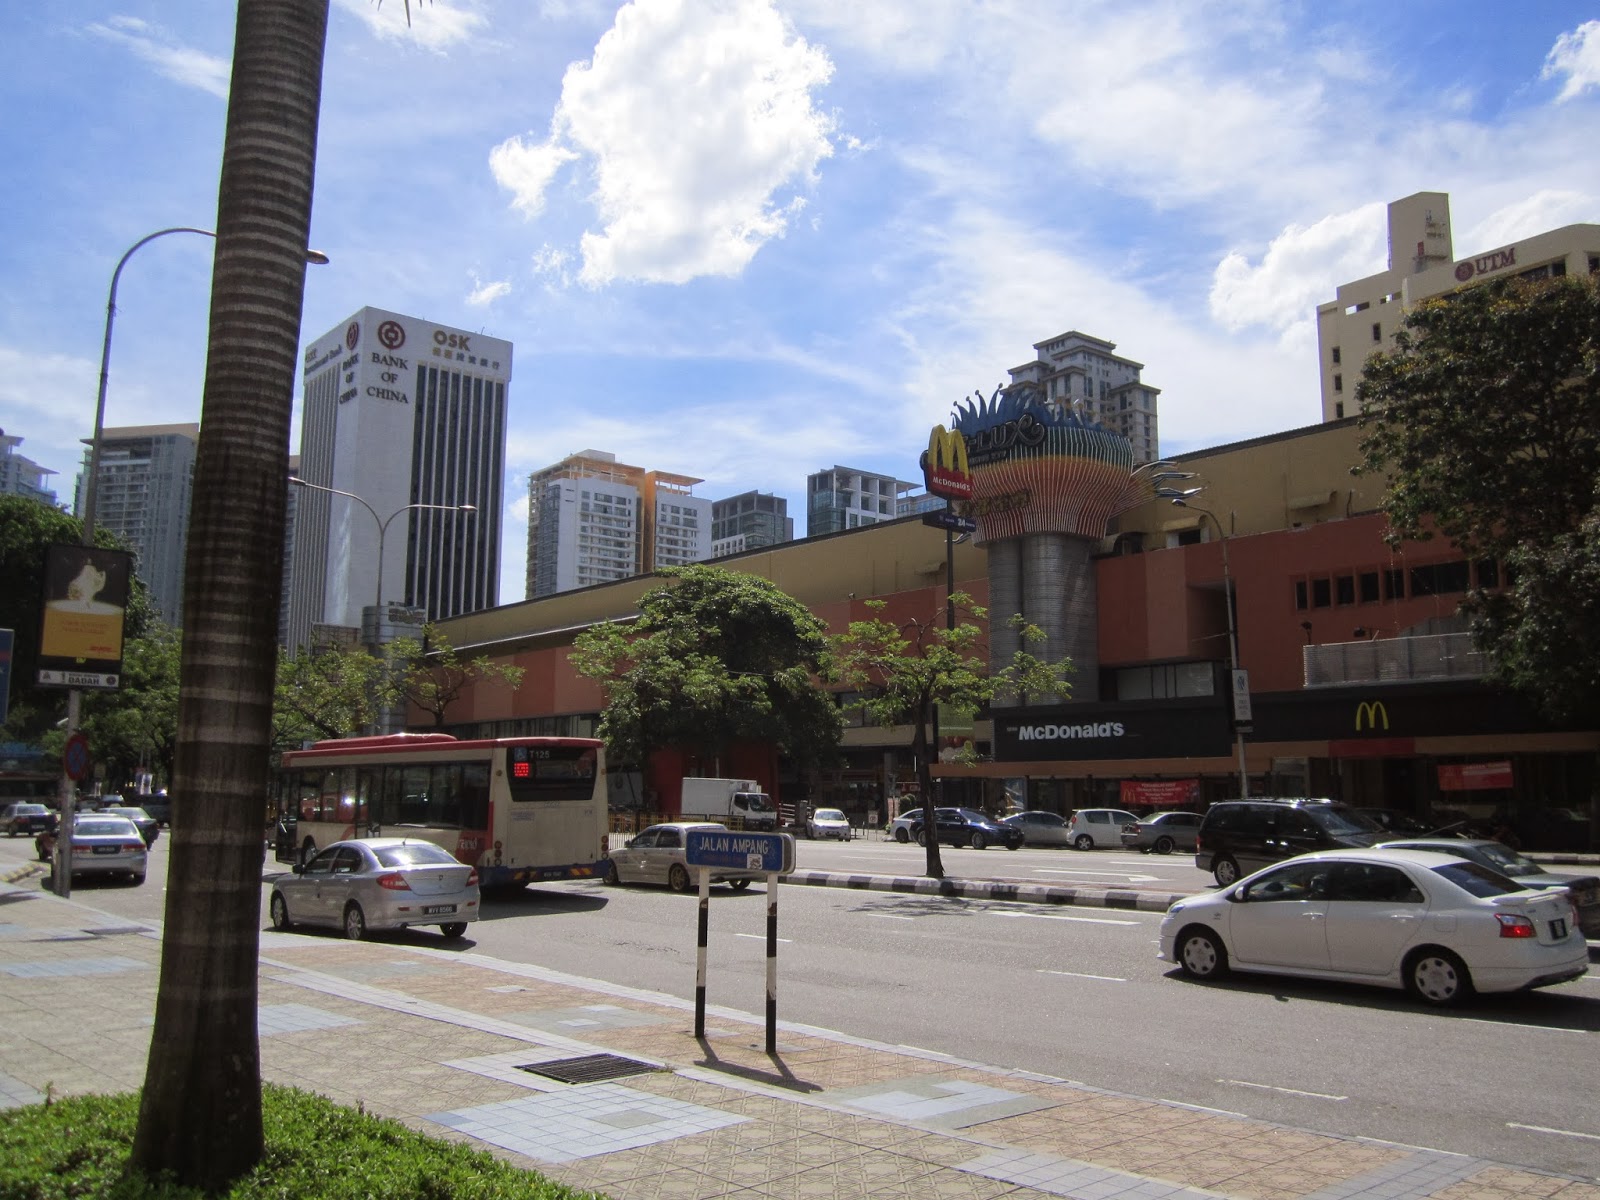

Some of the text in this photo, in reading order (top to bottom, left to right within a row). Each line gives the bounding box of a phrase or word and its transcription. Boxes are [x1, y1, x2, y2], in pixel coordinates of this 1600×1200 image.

[1474, 247, 1516, 276] UTM
[433, 329, 472, 352] OSK
[371, 352, 409, 370] BANK
[381, 371, 398, 384] OF
[366, 386, 410, 405] CHINA
[932, 476, 971, 491] McDonald's
[1018, 721, 1125, 741] McDonald's
[529, 750, 550, 759] T125
[699, 837, 769, 855] JALAN AMPANG
